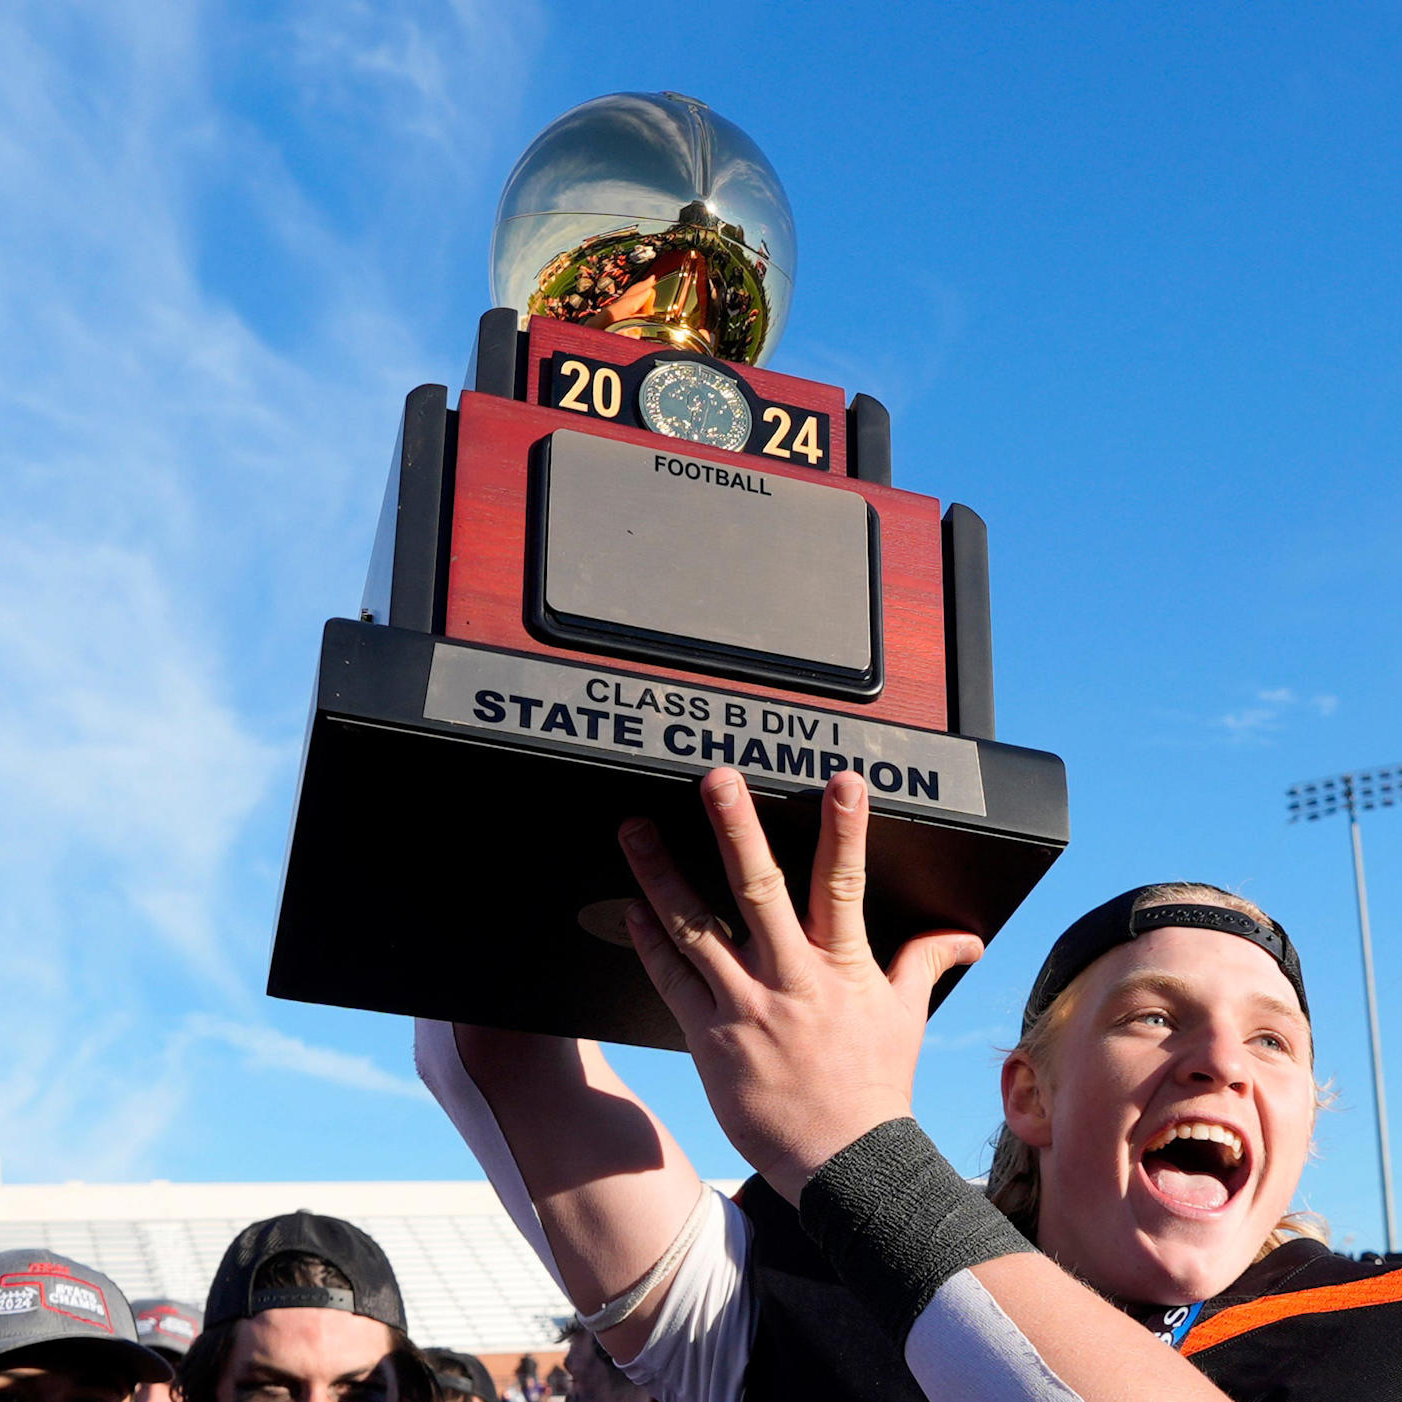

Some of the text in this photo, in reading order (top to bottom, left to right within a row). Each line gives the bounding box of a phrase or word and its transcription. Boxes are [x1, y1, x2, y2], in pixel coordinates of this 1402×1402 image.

[559, 359, 622, 419] 20
[762, 406, 823, 465] 24
[654, 454, 772, 496] FOOTBALL
[585, 677, 840, 746] CLASS B DIV I
[473, 689, 940, 801] STATE CHAMPION
